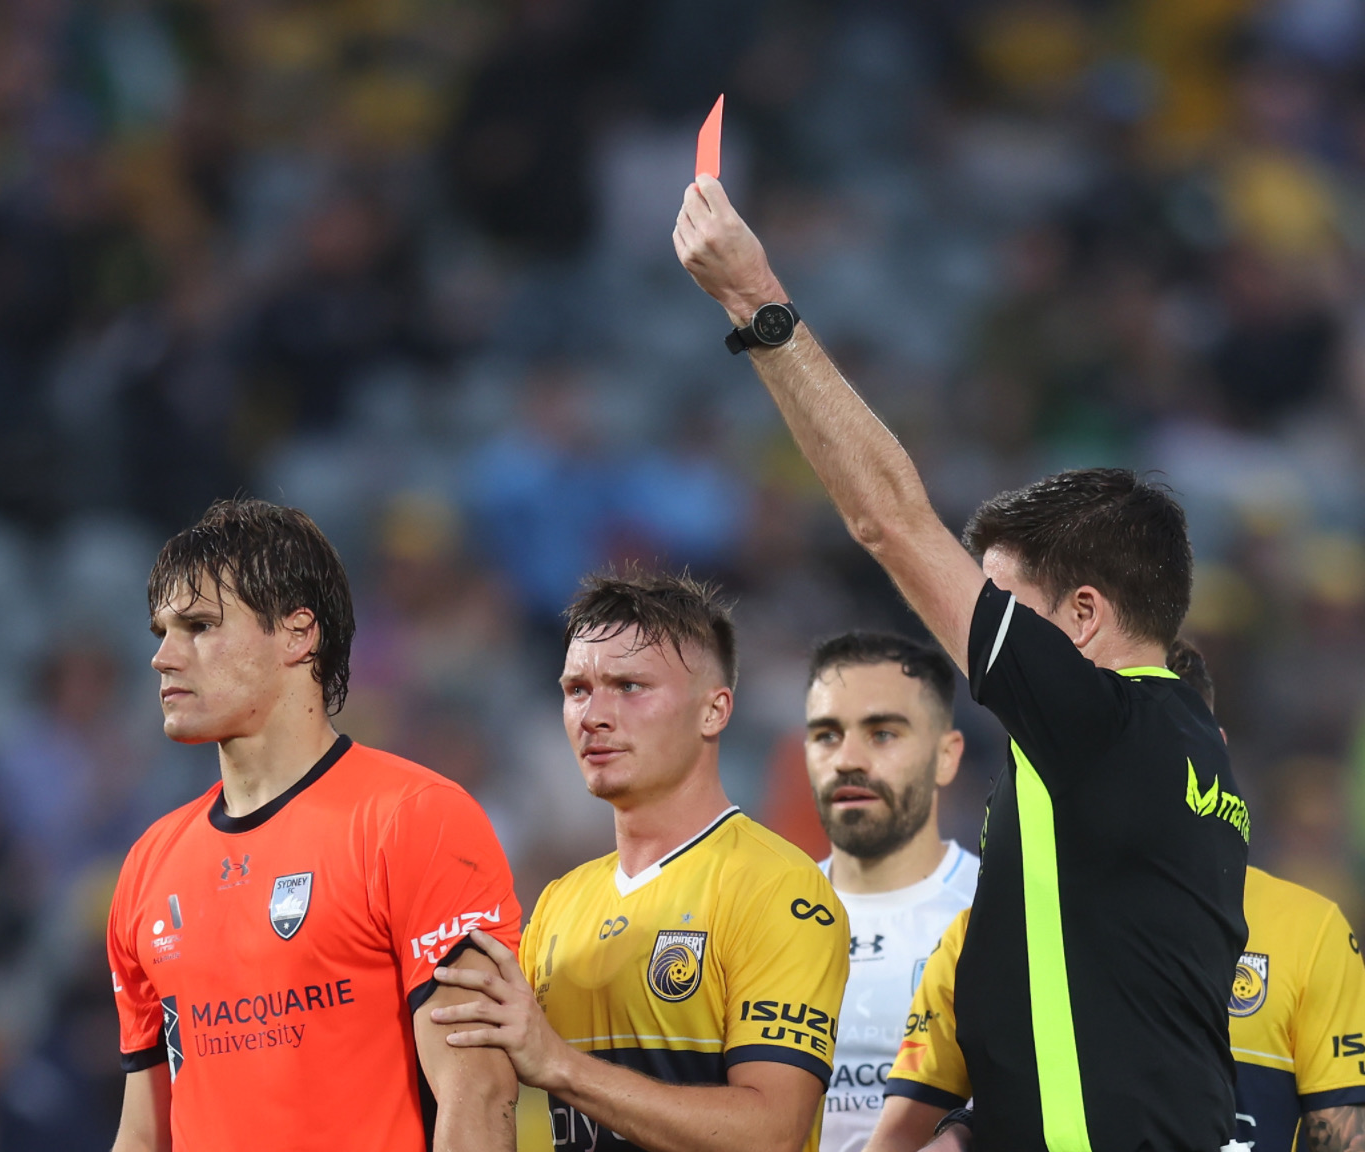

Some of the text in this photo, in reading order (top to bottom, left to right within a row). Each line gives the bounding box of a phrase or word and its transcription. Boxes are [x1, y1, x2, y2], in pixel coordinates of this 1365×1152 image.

[277, 877, 308, 890] SYDNEY
[411, 904, 501, 959] ISUZU
[653, 935, 705, 960] MARINERS
[192, 979, 355, 1028] MACQUARIE
[740, 1000, 840, 1044] ISUZU
[195, 1023, 306, 1057] University
[761, 1027, 828, 1056] UTE
